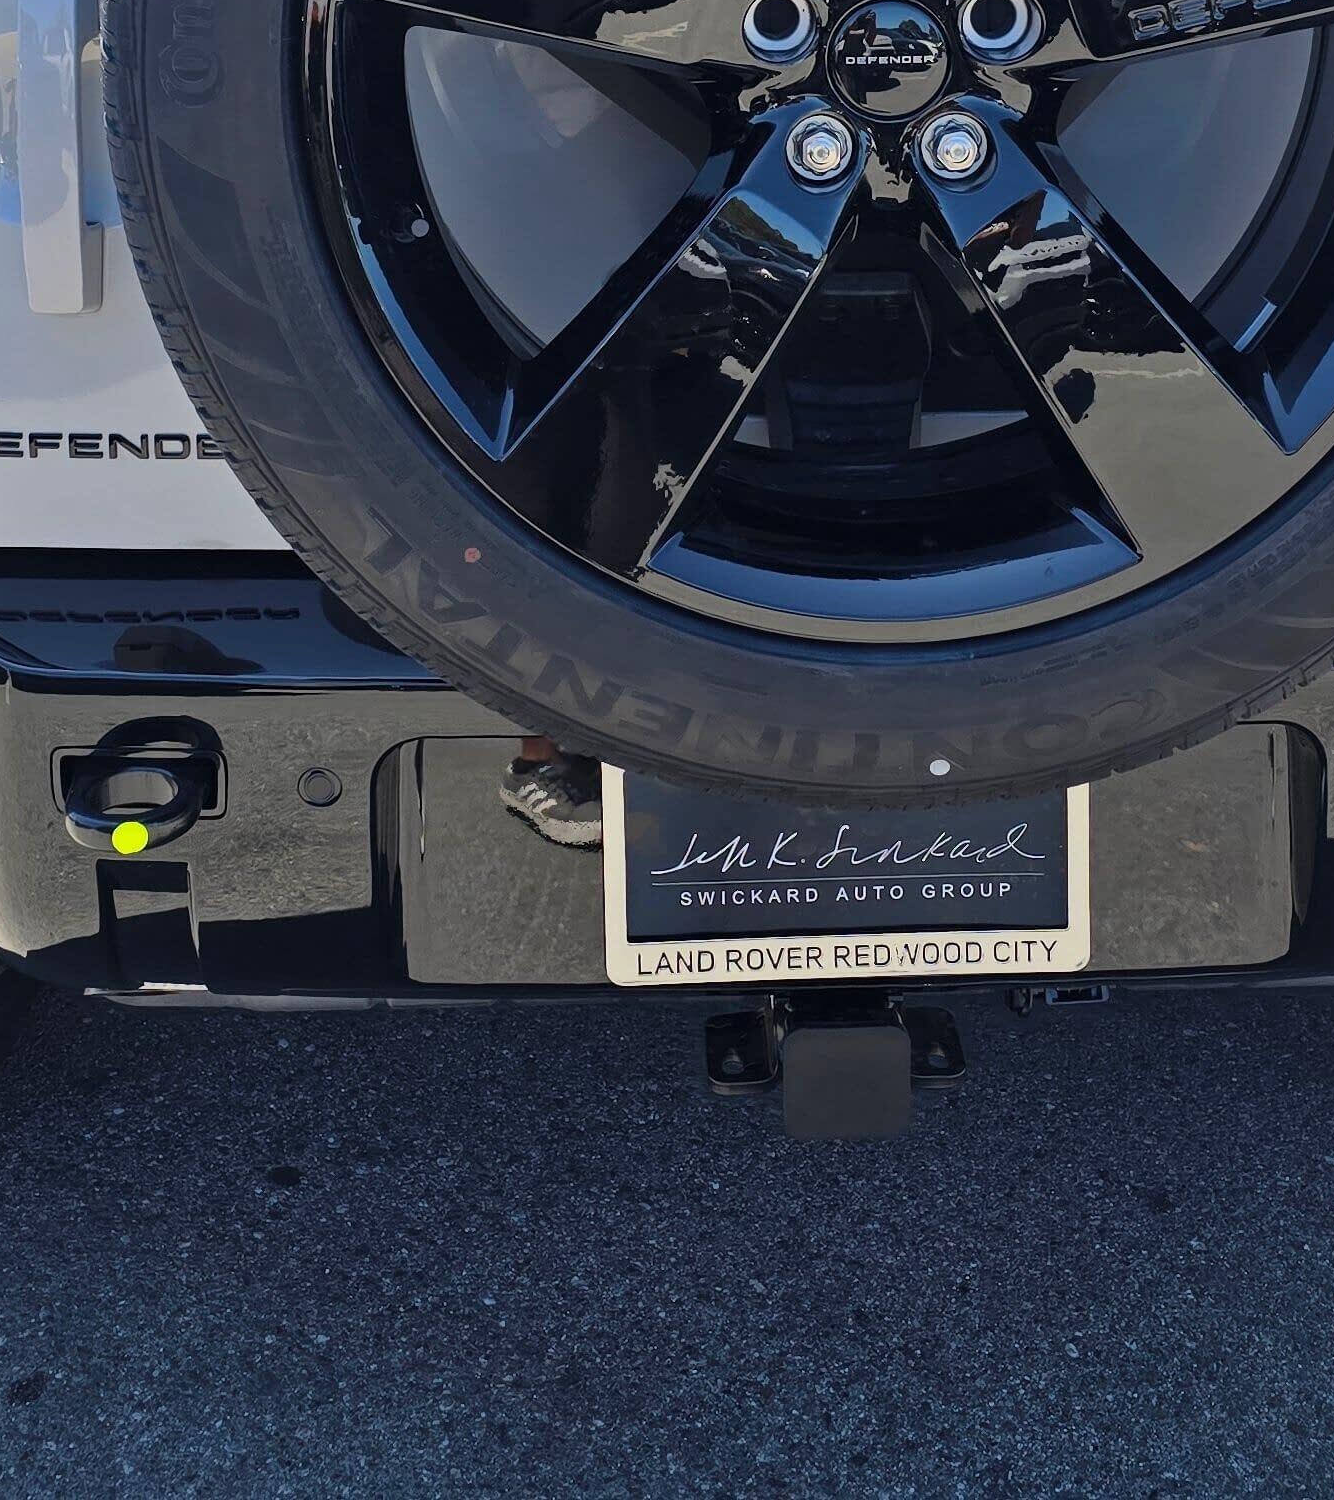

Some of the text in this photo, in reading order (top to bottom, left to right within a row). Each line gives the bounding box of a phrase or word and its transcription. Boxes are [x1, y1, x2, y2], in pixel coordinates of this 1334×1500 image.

[845, 54, 935, 65] DEFENDER
[680, 882, 1013, 907] SWICKARD AUTO GROUP
[637, 940, 1059, 976] LAND ROVER REDWOOD CITY
